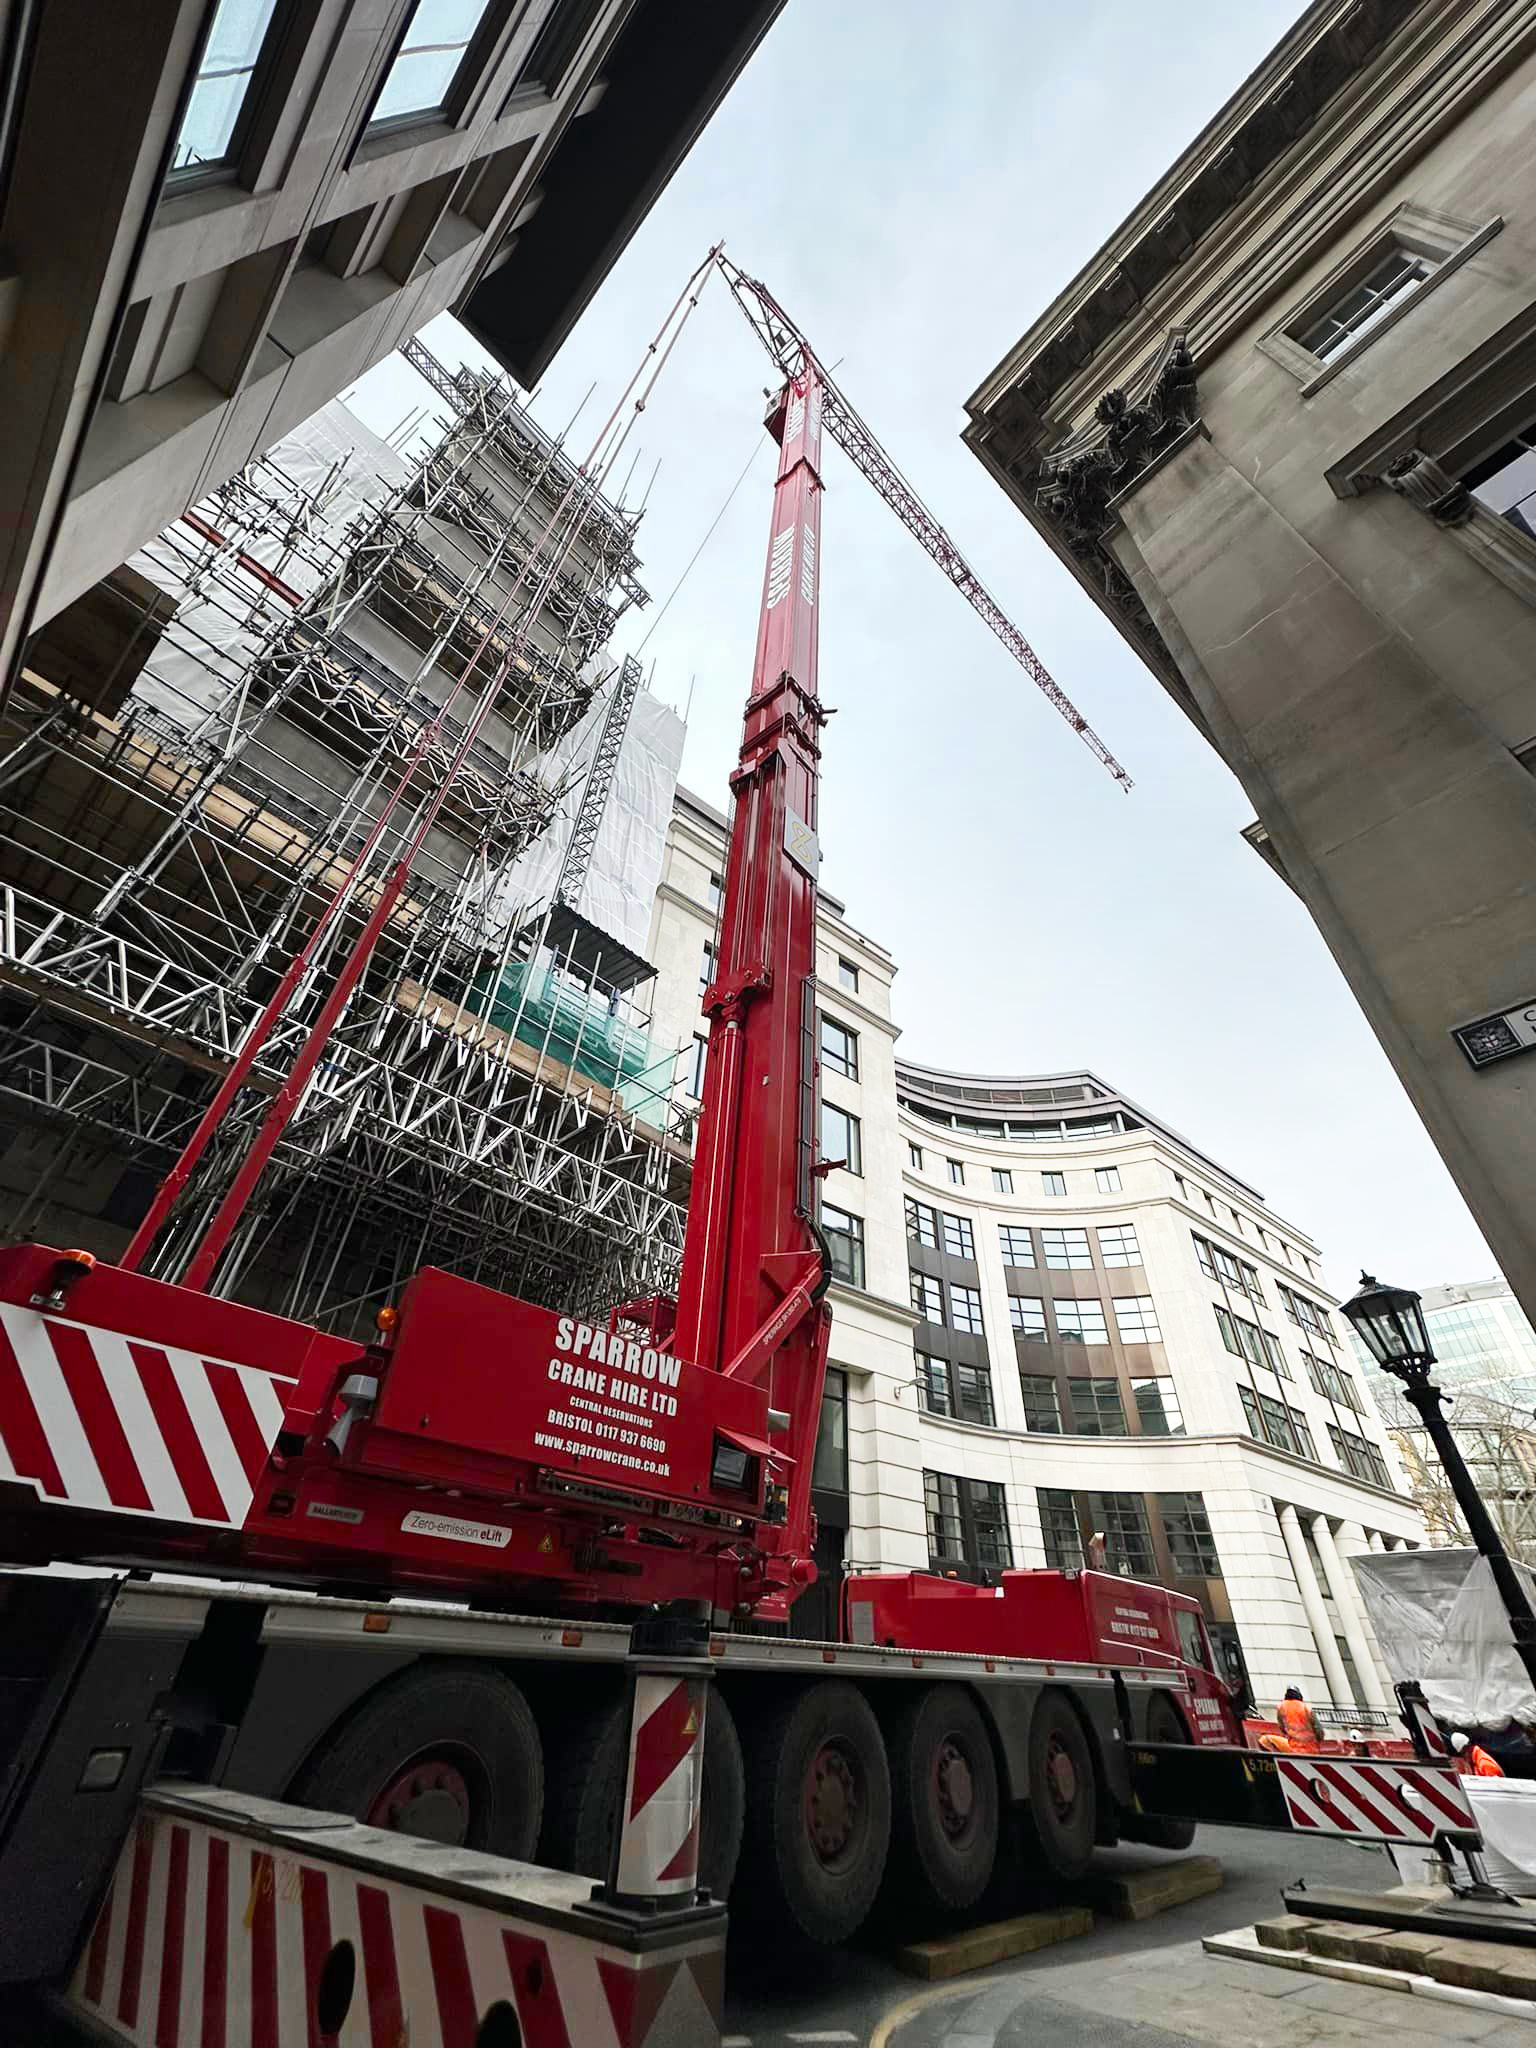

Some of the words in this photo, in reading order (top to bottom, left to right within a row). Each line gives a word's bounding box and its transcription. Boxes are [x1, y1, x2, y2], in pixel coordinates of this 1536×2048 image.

[767, 522, 795, 609] SPARROW
[555, 1317, 682, 1388] SPARROW
[548, 1358, 607, 1395] CRANE
[610, 1378, 648, 1408] HIRE
[651, 1391, 678, 1417] LTD
[547, 1409, 593, 1434] BRISTOL
[595, 1422, 619, 1440] 0117
[620, 1429, 638, 1446] 937
[640, 1434, 666, 1454] 6690
[569, 1395, 602, 1414] CENTRAL
[603, 1406, 653, 1429] RESERVATIONS
[534, 1431, 670, 1477] www.sparrowcrane.co.uk
[410, 1515, 479, 1539] Zero-emission
[480, 1528, 502, 1543] eLift
